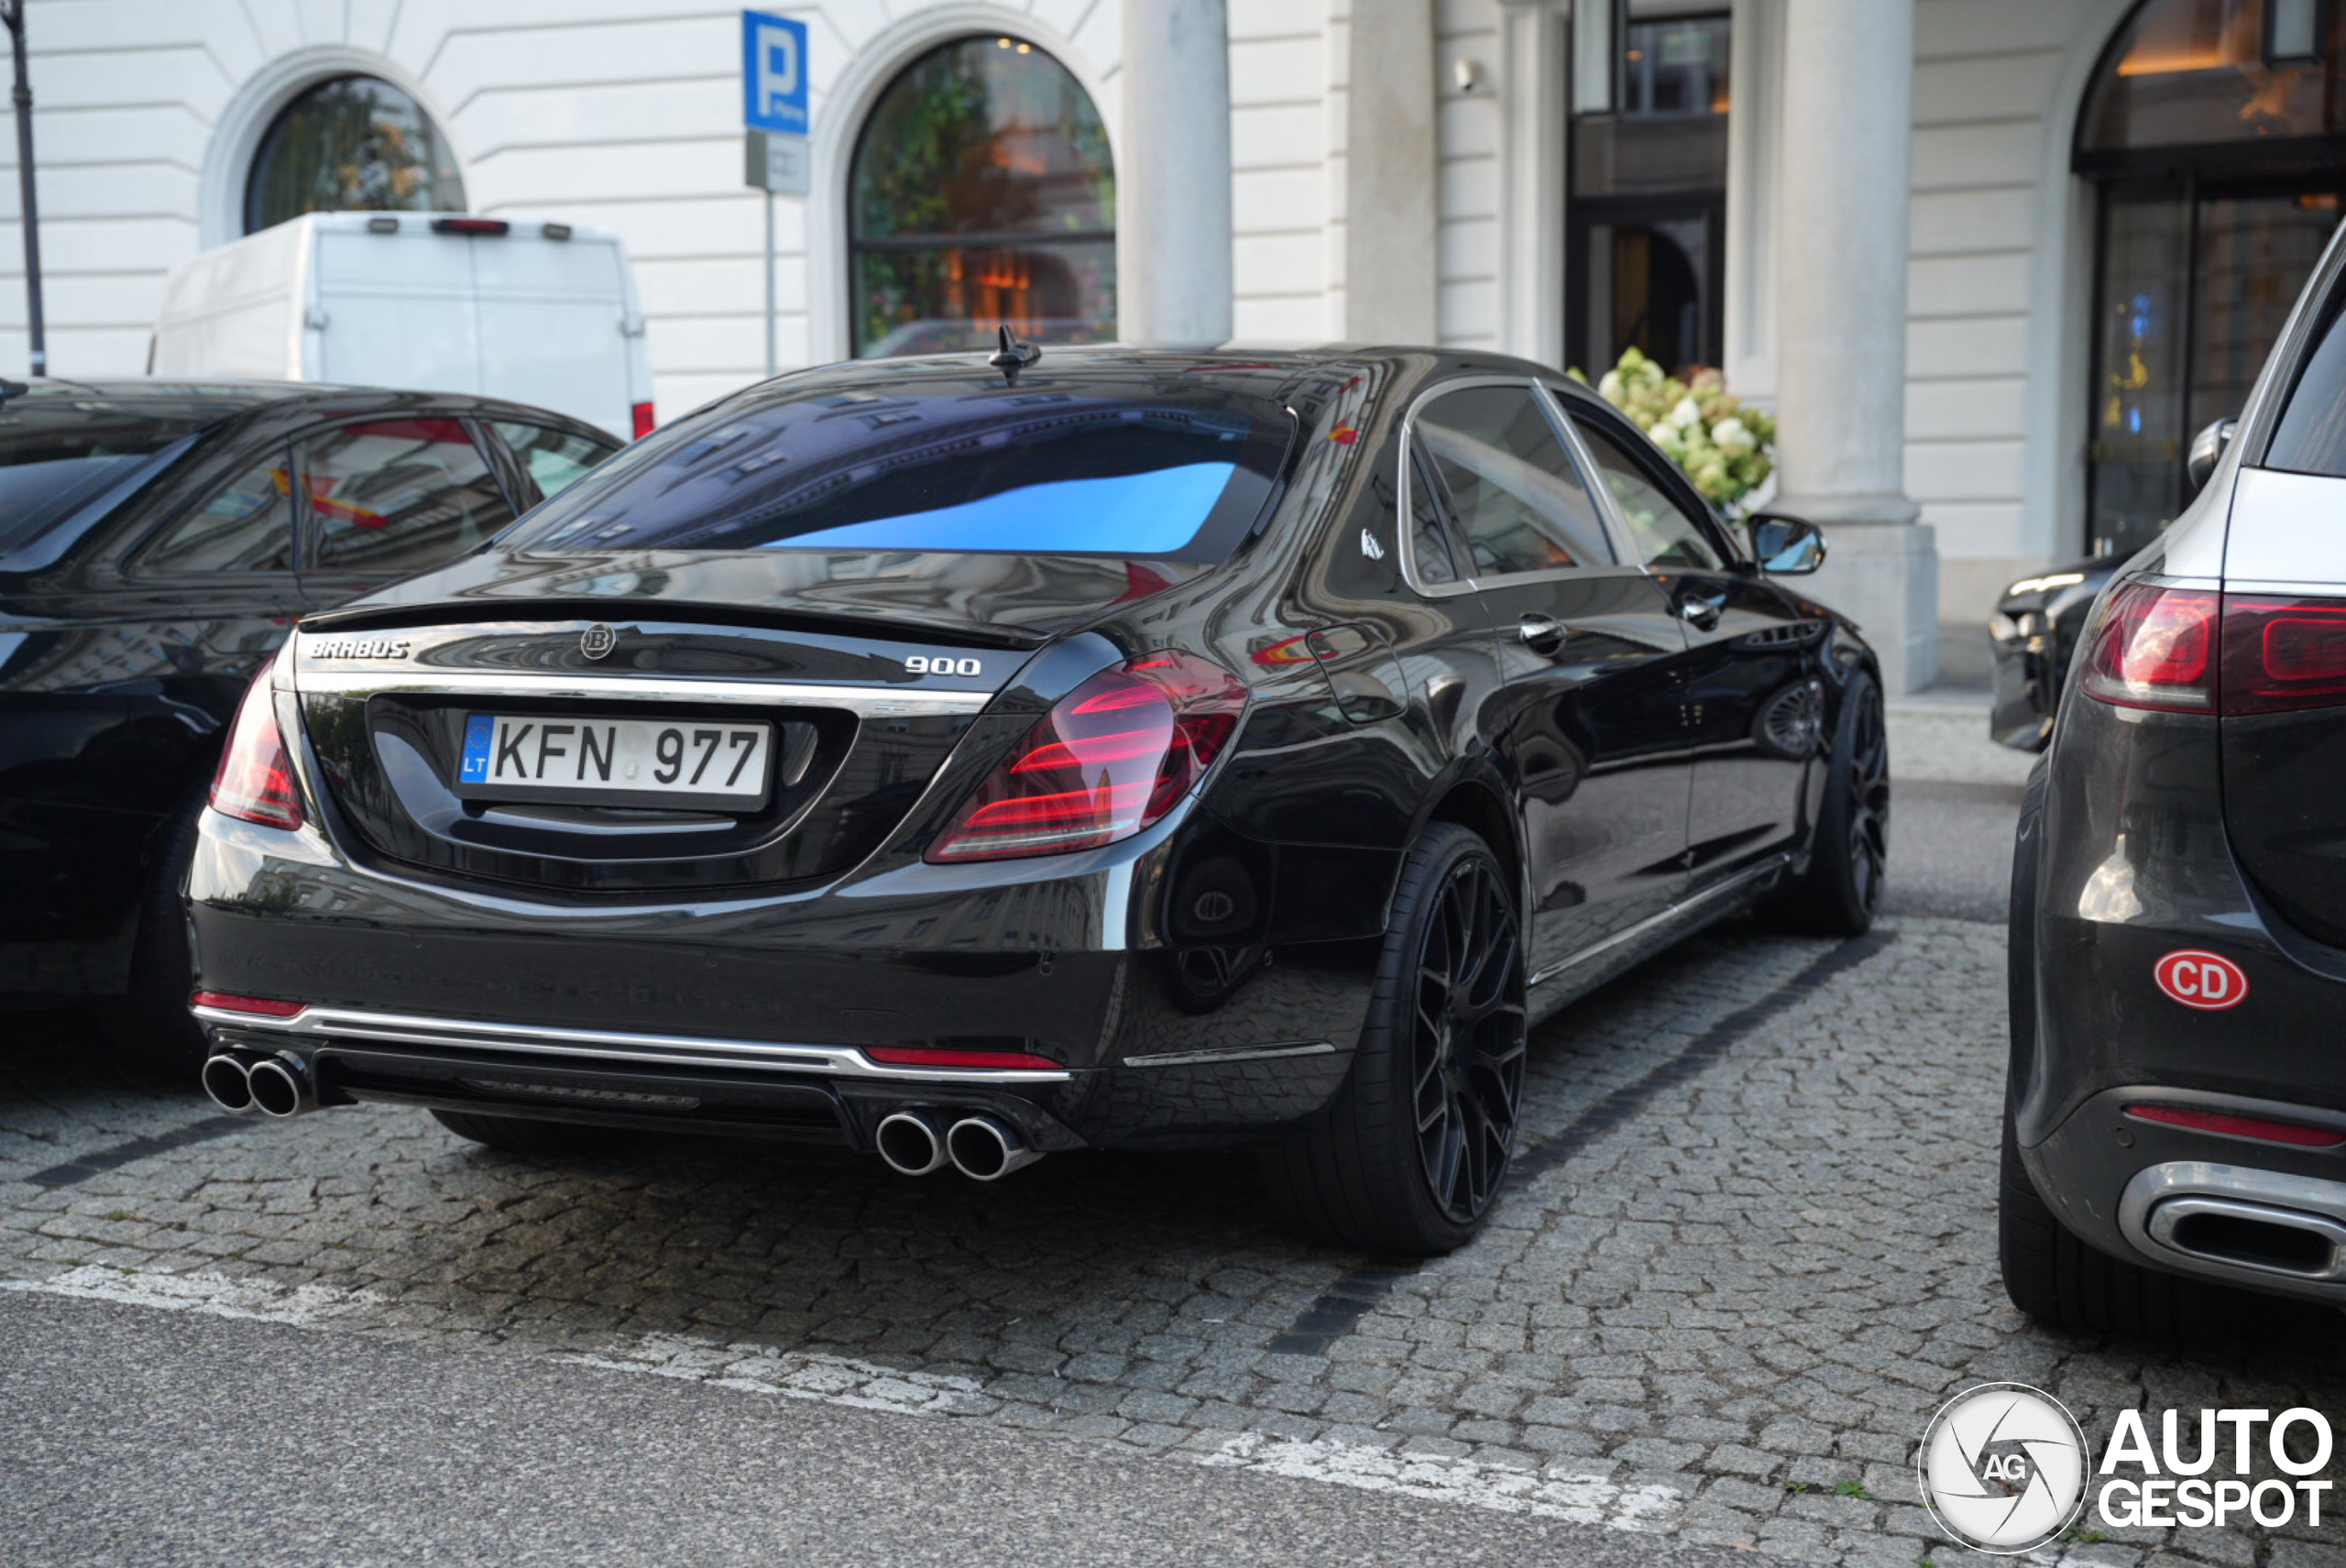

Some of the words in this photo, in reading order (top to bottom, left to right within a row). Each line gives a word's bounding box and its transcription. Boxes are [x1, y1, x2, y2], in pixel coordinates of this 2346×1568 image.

[757, 24, 798, 117] P
[311, 641, 410, 659] BRABUS
[905, 656, 981, 676] 900
[464, 757, 487, 773] LT
[495, 723, 616, 781] KFN
[653, 728, 759, 786] 977
[2172, 959, 2228, 999] CD
